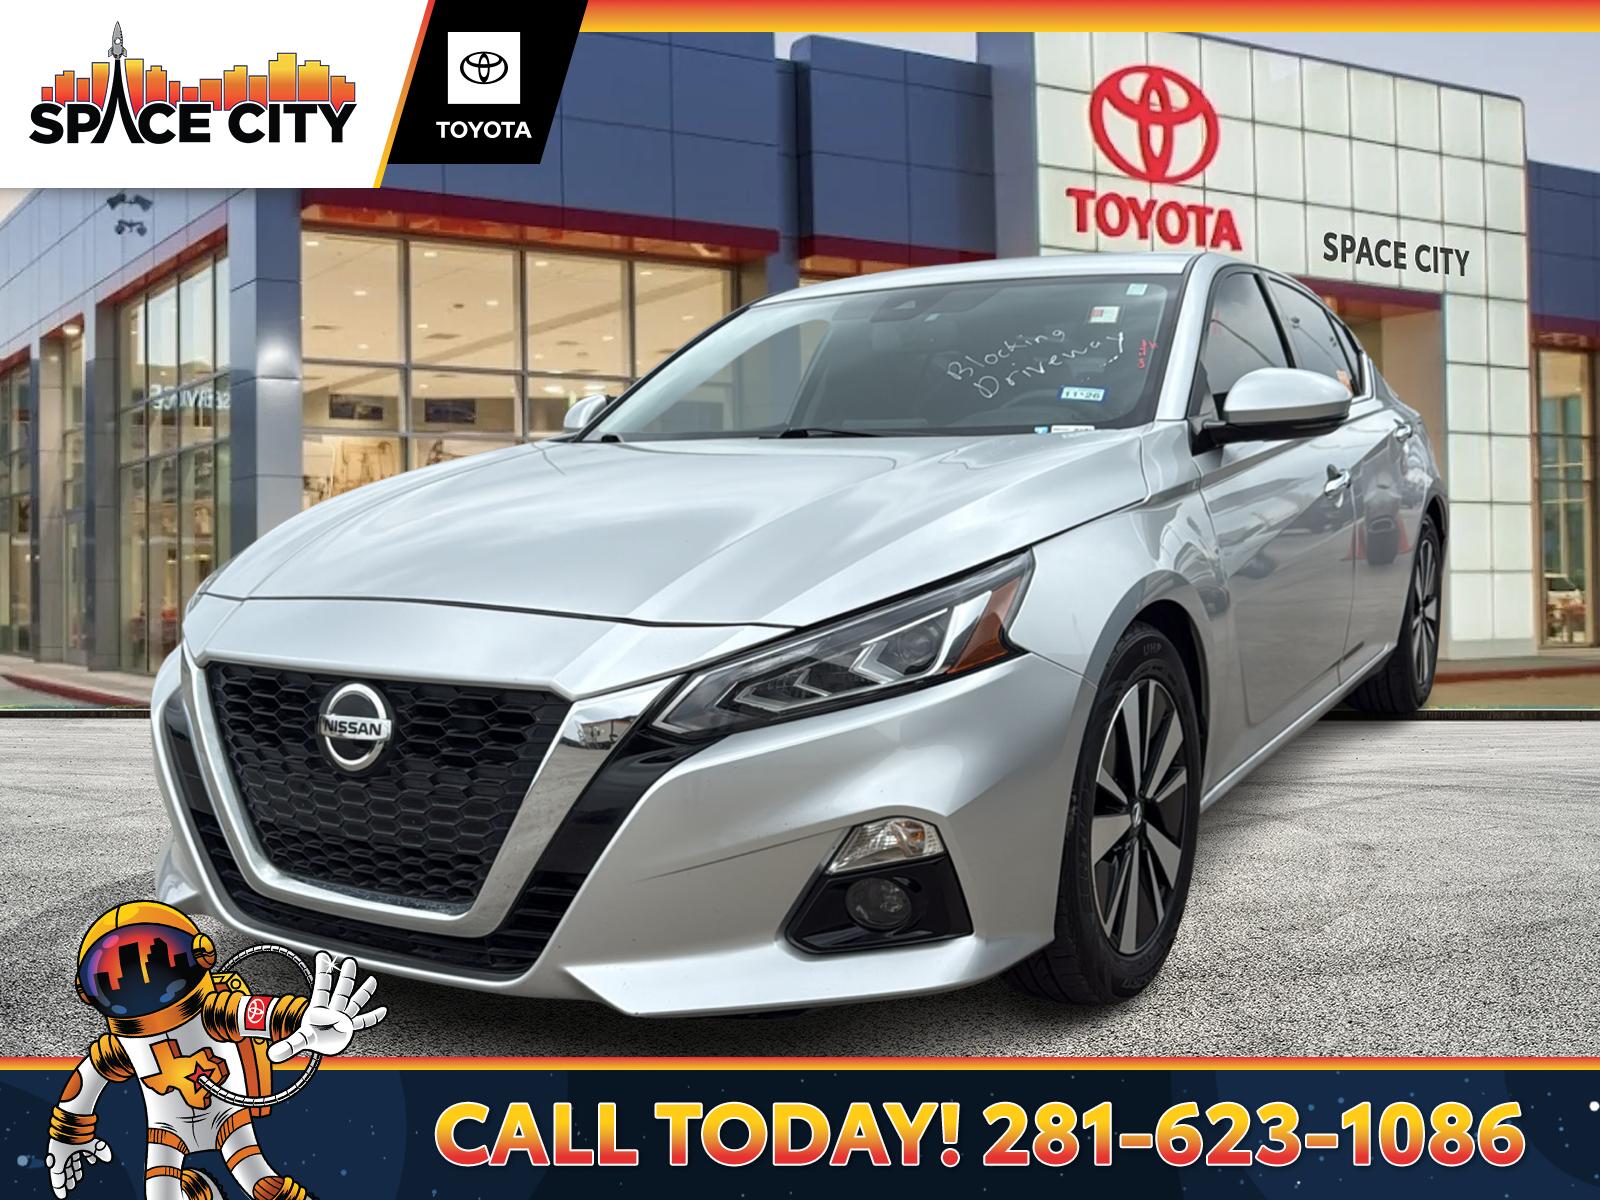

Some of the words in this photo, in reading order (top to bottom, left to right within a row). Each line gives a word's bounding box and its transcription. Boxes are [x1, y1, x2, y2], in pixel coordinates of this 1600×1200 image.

[1065, 187, 1243, 251] TOYOTA
[1323, 232, 1407, 270] SPACE
[1414, 244, 1471, 277] CITY
[947, 328, 1065, 380] Blocking
[973, 331, 1125, 399] Driveway
[323, 719, 382, 737] NISSAN
